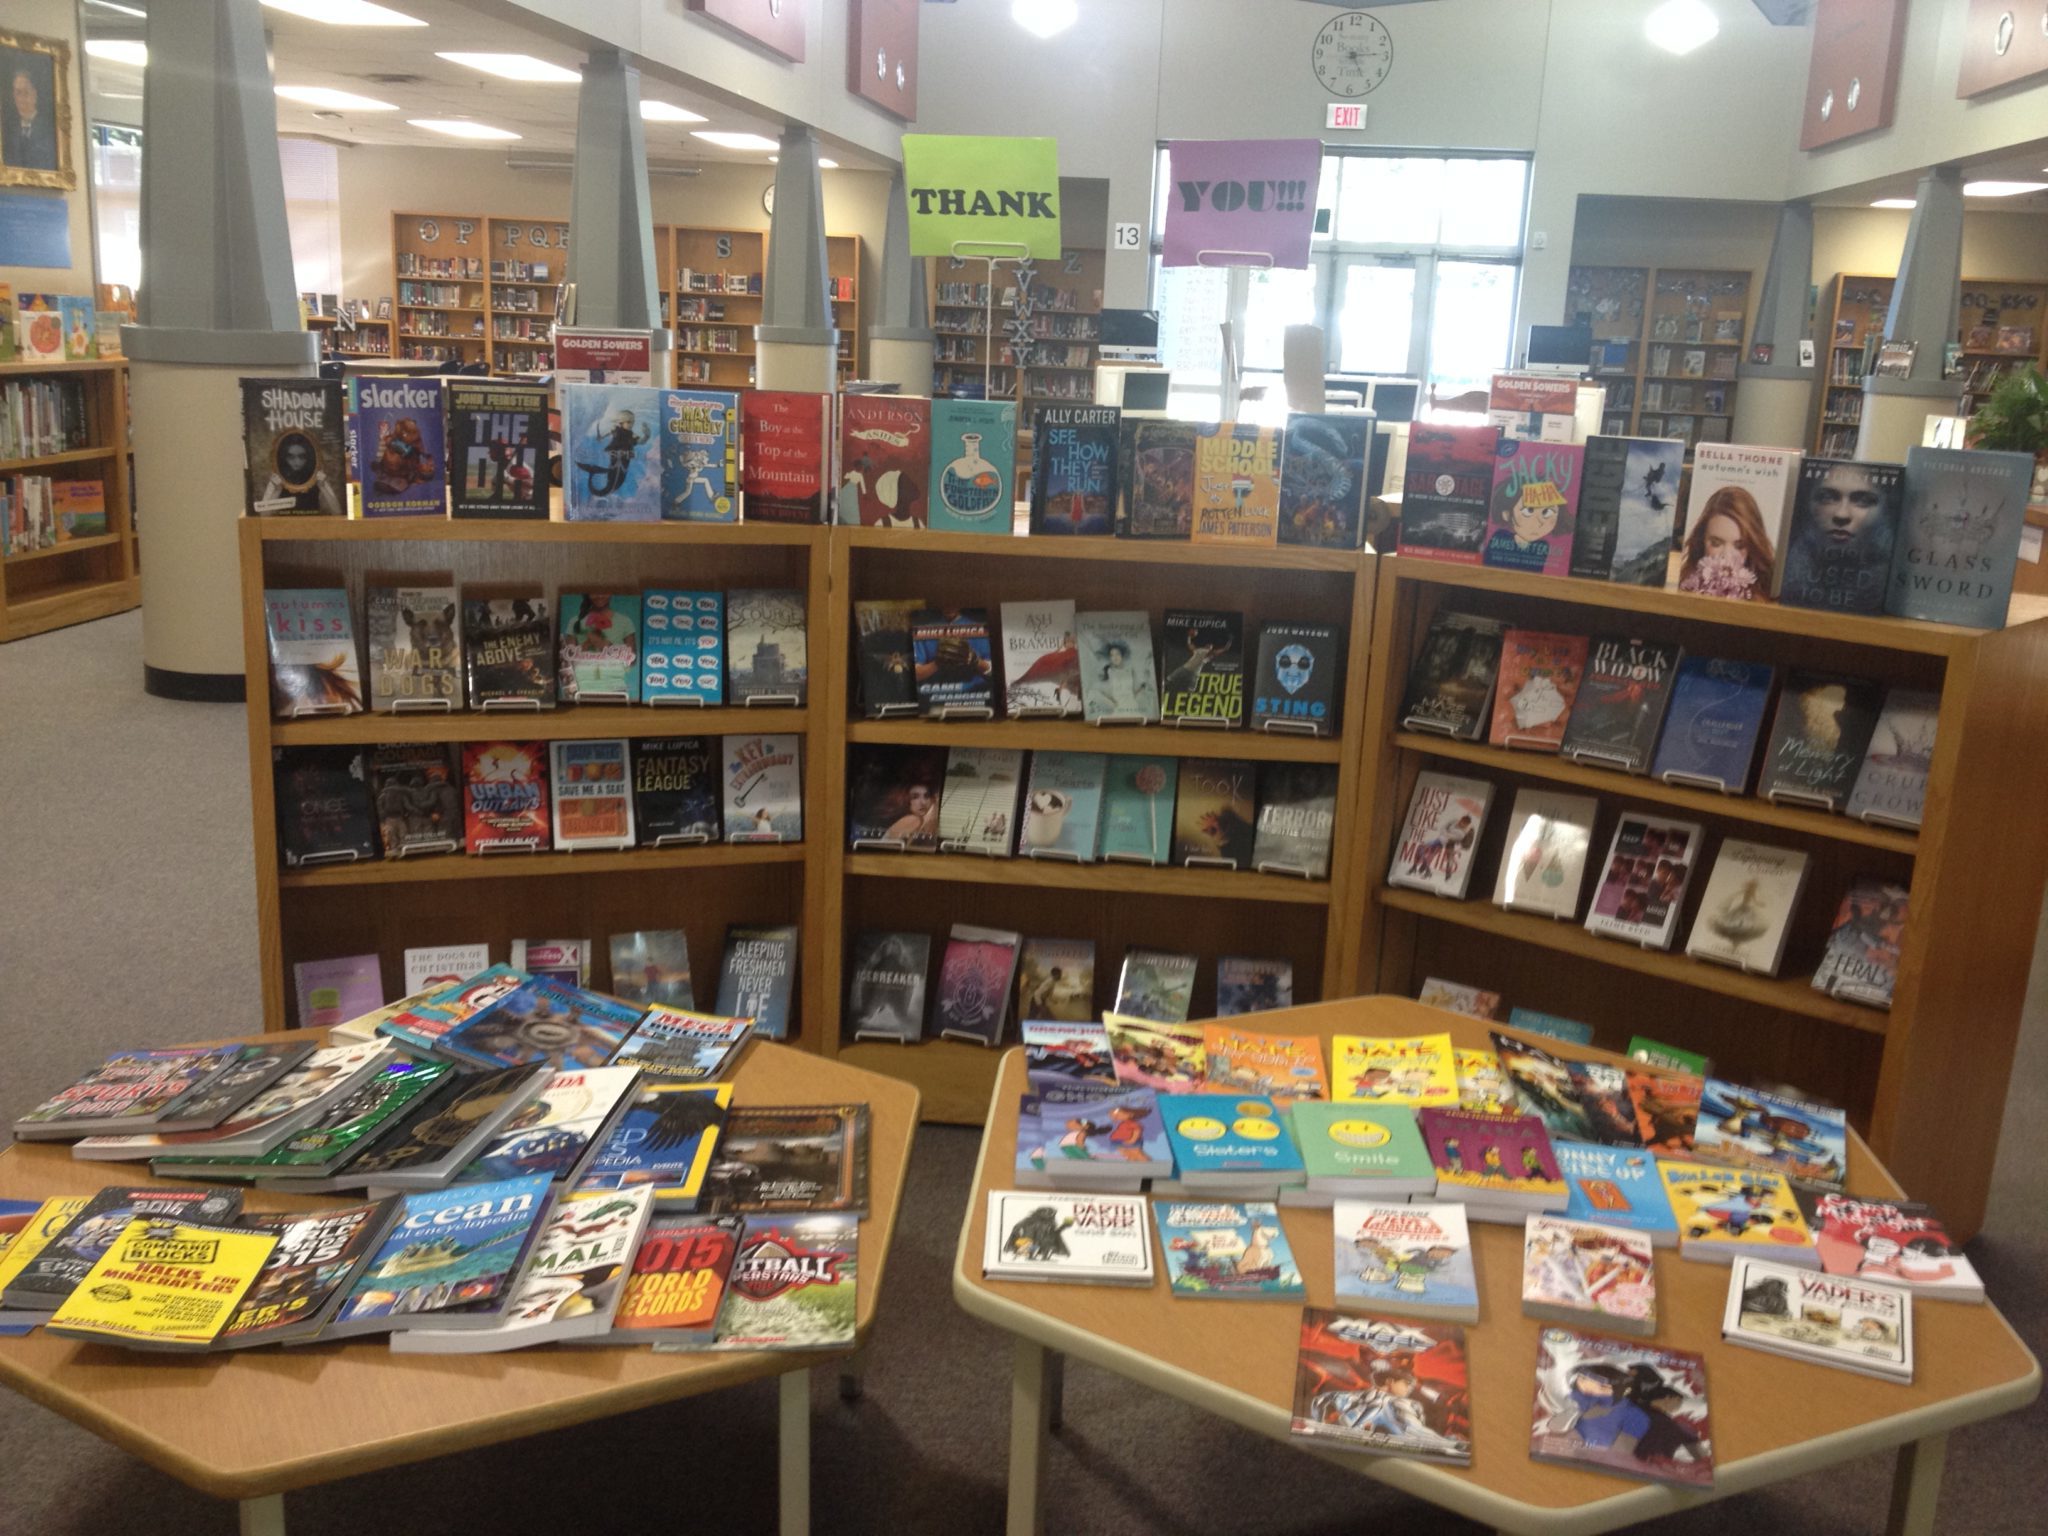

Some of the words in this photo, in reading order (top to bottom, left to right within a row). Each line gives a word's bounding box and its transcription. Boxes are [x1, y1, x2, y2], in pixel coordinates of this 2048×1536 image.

[1334, 21, 1344, 31] 11
[1350, 15, 1362, 26] 12
[1320, 34, 1333, 45] 10
[1379, 35, 1387, 46] 2
[1316, 48, 1323, 59] 9
[1319, 65, 1326, 76] 8
[1346, 84, 1353, 95] 6
[1334, 106, 1361, 127] EXIT
[911, 188, 1058, 219] THANK
[1177, 179, 1307, 213] YOU!!!
[455, 220, 475, 243] P
[504, 224, 522, 247] P
[529, 225, 549, 249] Q
[1116, 227, 1140, 245] 13
[716, 235, 732, 259] S
[332, 306, 357, 332] N
[562, 338, 600, 349] GOLDEN
[602, 340, 643, 351] SOWERS
[360, 383, 438, 408] slacker
[1497, 380, 1531, 391] GOLDEN
[1533, 381, 1570, 393] SOWERS
[262, 388, 326, 410] SHADOW
[455, 393, 485, 405] JOHN
[773, 403, 789, 413] The
[265, 410, 323, 431] HOUSE
[1045, 409, 1072, 424] ALLY
[1074, 410, 1116, 425] CARTER
[470, 412, 529, 445] THE
[759, 420, 783, 436] Boy
[1049, 429, 1077, 445] SEE
[755, 443, 781, 460] Top
[1068, 442, 1109, 461] HOW
[1201, 438, 1278, 459] MIDDLE
[1700, 450, 1733, 462] BELLA
[1738, 453, 1784, 466] THORNE
[1051, 457, 1092, 477] THEY
[1201, 456, 1277, 475] SCHOOL
[1499, 451, 1575, 497] JACKY
[1755, 466, 1780, 478] wish
[747, 467, 815, 485] Mountain
[1067, 477, 1101, 493] RUN
[1907, 549, 1993, 573] GLASS
[1895, 573, 1994, 600] SWORD
[276, 613, 344, 633] kiss
[1026, 612, 1052, 626] ASH
[1167, 617, 1190, 628] MIKE
[1196, 619, 1227, 629] LUPICA
[500, 632, 541, 649] ENEMY
[917, 628, 944, 637] MIKE
[946, 627, 985, 636] LUPICA
[1009, 637, 1066, 650] BRAMBL
[382, 648, 443, 673] WAR
[476, 648, 522, 667] ABOVE
[1594, 641, 1668, 669] BLACK
[1593, 658, 1664, 683] WIDOW
[379, 674, 454, 697] DOGS
[1198, 674, 1243, 695] TRUE
[1163, 693, 1243, 719] LEGEND
[1255, 697, 1326, 717] STING
[641, 741, 664, 751] MIKE
[636, 756, 711, 776] FANTASY
[1794, 764, 1847, 785] Light
[470, 783, 540, 800] URBAN
[558, 785, 581, 797] SAVE
[582, 785, 594, 795] ME
[636, 774, 692, 792] LEAGUE
[470, 797, 540, 814] OUTLAWS
[1416, 786, 1452, 811] JUST
[1855, 792, 1922, 812] CROW
[1261, 805, 1327, 828] TERROR
[1410, 809, 1441, 831] LIKE
[411, 953, 433, 964] THE
[436, 952, 466, 962] DOGS
[469, 951, 483, 960] OF
[734, 940, 785, 959] SLEEPING
[729, 958, 786, 977] FRESHMEN
[1834, 952, 1889, 987] FERALS
[738, 976, 773, 993] NEVER
[857, 969, 921, 986] ICEBREAKER
[1193, 1144, 1279, 1157] Sisters
[1334, 1151, 1400, 1165] Smile
[1615, 1166, 1646, 1181] UP
[132, 1200, 189, 1216] 2016
[403, 1191, 534, 1230] cean
[1073, 1203, 1135, 1216] DARTH
[415, 1210, 529, 1238] encyclopedia
[1073, 1216, 1135, 1229] VADER
[131, 1241, 213, 1252] COMMAND
[637, 1233, 723, 1273] 015
[128, 1250, 209, 1263] BLOCKS
[101, 1269, 235, 1295] MINECRAFTERS
[136, 1262, 206, 1281] HACKS
[212, 1275, 241, 1286] FOR
[1800, 1279, 1896, 1309] VADER'S
